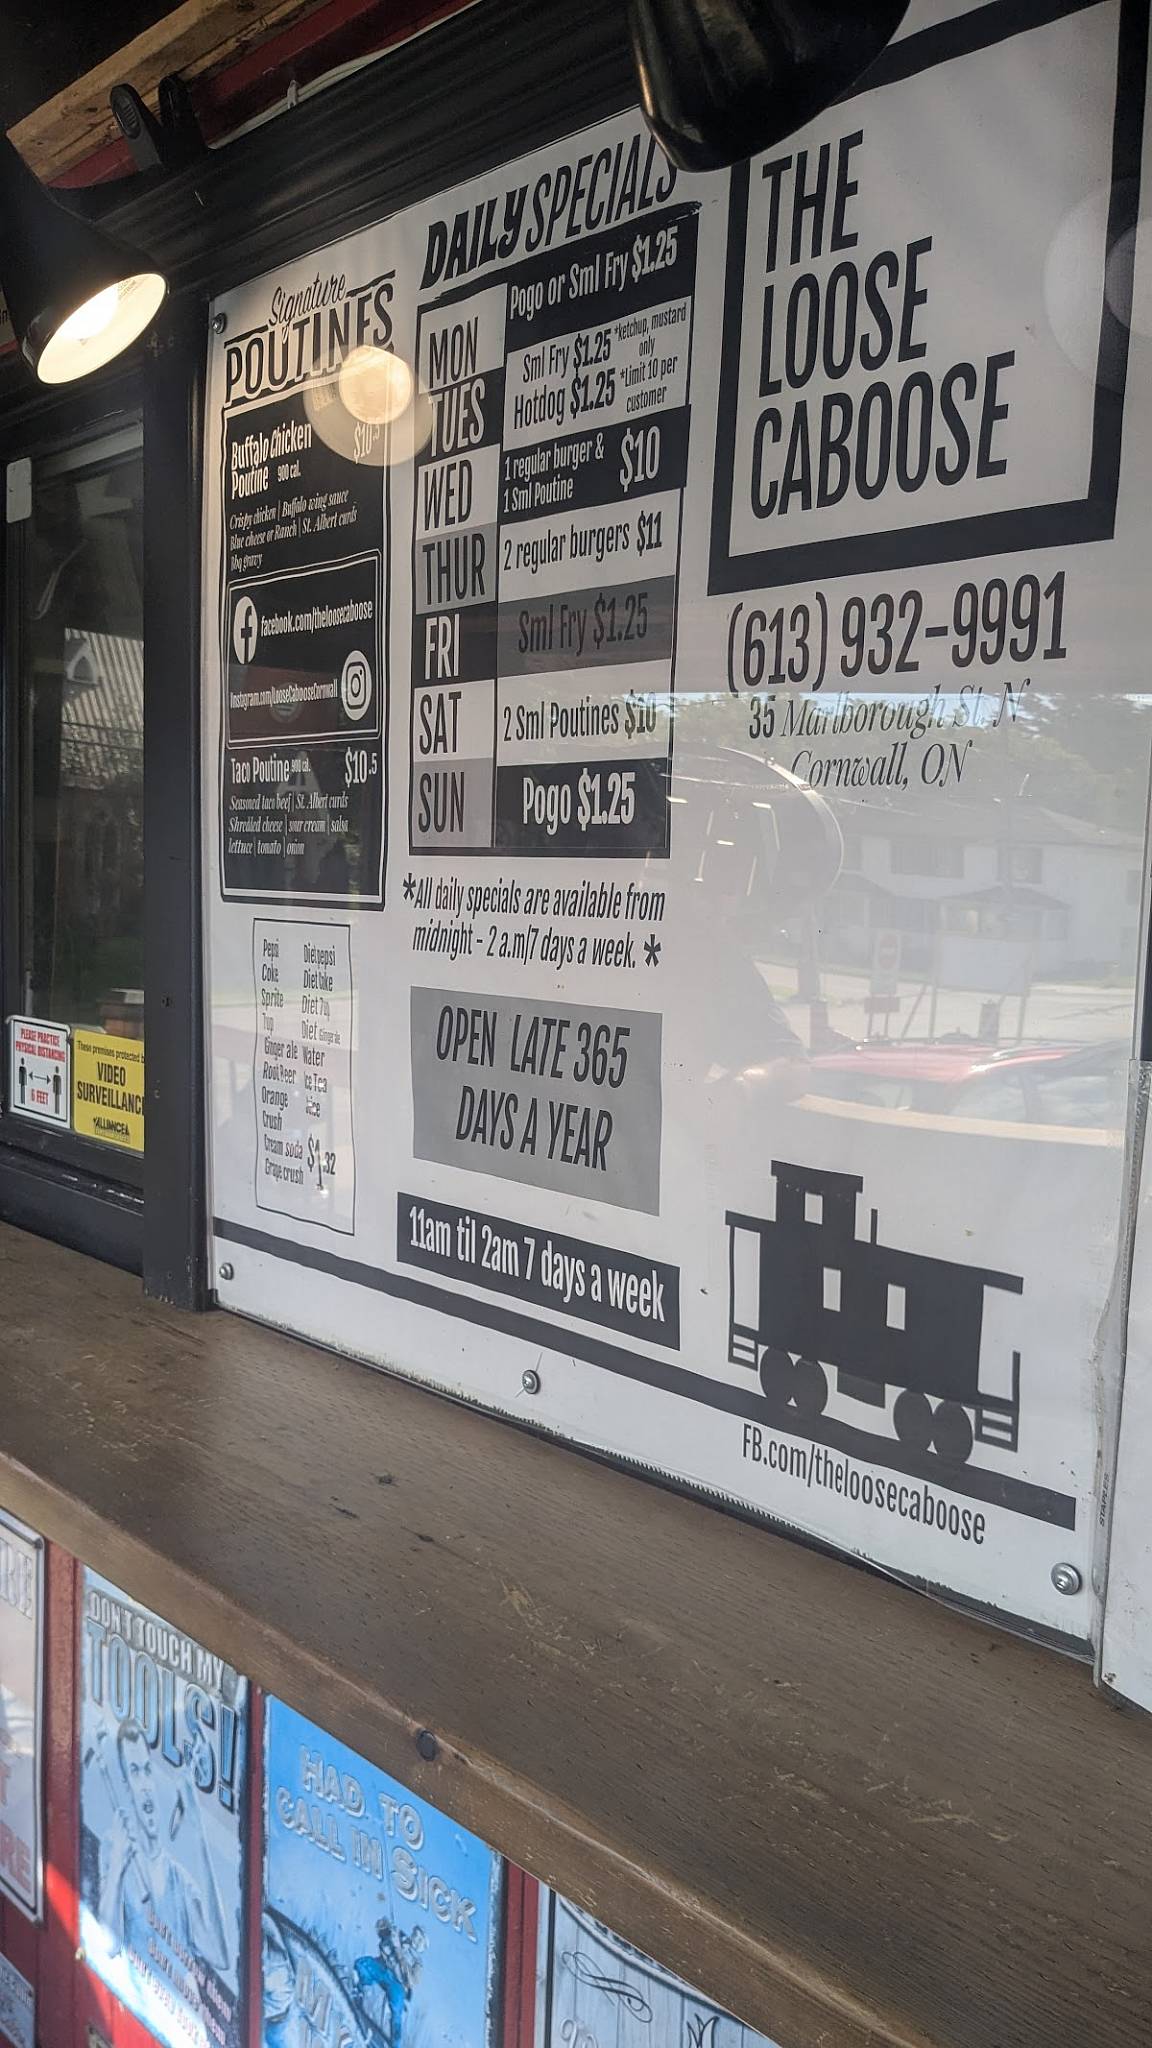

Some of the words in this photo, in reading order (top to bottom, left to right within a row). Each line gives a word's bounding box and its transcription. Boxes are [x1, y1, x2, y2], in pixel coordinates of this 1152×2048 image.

[762, 129, 864, 273] THE
[420, 184, 530, 290] DAILY
[509, 284, 543, 322] Pogo
[548, 275, 565, 306] or
[569, 254, 600, 300] Sml
[605, 251, 629, 294] Fry
[631, 225, 678, 283] $1.25
[269, 271, 346, 333] Signature
[651, 302, 687, 330] mustard
[759, 236, 933, 398] LOOSE
[224, 282, 395, 404] POUTINES
[429, 317, 479, 389] MON
[523, 345, 545, 384] Sml
[549, 343, 569, 379] Fry
[573, 328, 612, 372] $1.25
[639, 335, 655, 358] only
[648, 358, 658, 380] 10
[660, 355, 678, 382] per
[431, 378, 486, 458] TUES
[513, 384, 565, 430] Hotdog
[571, 369, 615, 420] $1.25
[626, 386, 667, 413] customer
[231, 432, 269, 470] Buffalo
[270, 420, 312, 458] Chicken
[504, 456, 511, 481] 1
[513, 443, 551, 483] regular
[553, 437, 593, 472] burger
[595, 431, 604, 460] &
[619, 425, 661, 492] $10
[751, 350, 1015, 519] CABOOSE
[230, 512, 253, 530] Crispy
[254, 505, 277, 522] chicken
[282, 495, 307, 518] Buffalo
[308, 493, 328, 511] wing
[328, 490, 349, 507] sauce
[231, 466, 269, 499] Poutine
[424, 459, 473, 531] WED
[503, 491, 510, 513] 1
[511, 483, 532, 512] Sml
[534, 473, 574, 509] Poutine
[245, 531, 266, 546] cheese
[267, 529, 275, 542] or
[275, 520, 298, 540] Ranch
[313, 511, 338, 532] Albert
[503, 539, 512, 571] 2
[516, 530, 566, 575] regular
[570, 522, 630, 563] burgers
[636, 510, 662, 557] $11
[422, 533, 486, 605] THUR
[261, 599, 373, 637] facebook.com/theloosecaboose
[518, 604, 553, 653] Sml
[560, 603, 588, 657] Fry
[593, 592, 648, 649] $1.25
[727, 591, 828, 698] (613)
[840, 570, 1067, 678] 932-9991
[424, 613, 461, 680] FRI
[419, 691, 462, 755] SAT
[503, 706, 512, 742] 2
[515, 701, 545, 741] Sml
[550, 695, 619, 741] Poutines
[625, 688, 657, 739] $10
[750, 695, 776, 739] 35
[780, 684, 946, 739] Marlborough
[952, 684, 985, 728] St.
[993, 678, 1031, 728] N
[231, 758, 251, 784] Taco
[252, 753, 290, 783] Poutine
[791, 742, 908, 790] Cornwall,
[921, 740, 974, 787] ON
[276, 792, 292, 813] beef
[331, 815, 349, 833] salsa
[418, 771, 465, 833] SUN
[522, 777, 571, 836] Pogo
[577, 768, 636, 833] $1.25
[228, 837, 253, 855] lettuce
[257, 840, 282, 855] tomato
[435, 877, 465, 918] daily
[466, 877, 521, 920] specials
[523, 887, 550, 916] are
[552, 879, 620, 920] available
[625, 882, 666, 922] from
[412, 918, 473, 961] midnight
[486, 925, 498, 958] 2
[540, 926, 574, 971] days
[577, 937, 588, 964] a
[591, 931, 637, 969] week.
[261, 987, 284, 1011] Sprite
[262, 963, 279, 983] Coke
[303, 968, 318, 989] Diet
[302, 994, 318, 1015] Diet
[302, 1019, 317, 1040] Diet
[97, 1062, 126, 1087] VIDEO
[286, 1039, 298, 1060] ale
[302, 1045, 325, 1067] Water
[436, 1005, 497, 1067] OPEN
[510, 1014, 571, 1079] LATE
[573, 1022, 631, 1089] 365
[262, 1085, 288, 1111] Orange
[262, 1110, 282, 1131] Crush
[285, 1140, 303, 1160] soda
[455, 1085, 519, 1151] DAYS
[519, 1097, 538, 1156] A
[547, 1100, 613, 1171] YEAR
[283, 1166, 304, 1185] crush
[409, 1205, 450, 1257] 11am
[456, 1215, 476, 1263] til
[481, 1224, 520, 1277] 2am
[524, 1237, 536, 1281] 7
[541, 1239, 585, 1303] days
[591, 1264, 602, 1302] a
[608, 1268, 665, 1322] week
[742, 1422, 986, 1545] FB.com/theloosecaboose
[90, 1591, 133, 1640] DON'T
[136, 1619, 193, 1675] TOUCH
[197, 1646, 226, 1695] MY
[87, 1619, 235, 1814] TOOLS!
[301, 1746, 366, 1818] HAD
[378, 1792, 424, 1850] TO
[277, 1786, 347, 1863] CALL
[352, 1829, 383, 1882] IN
[391, 1847, 477, 1944] SICK
